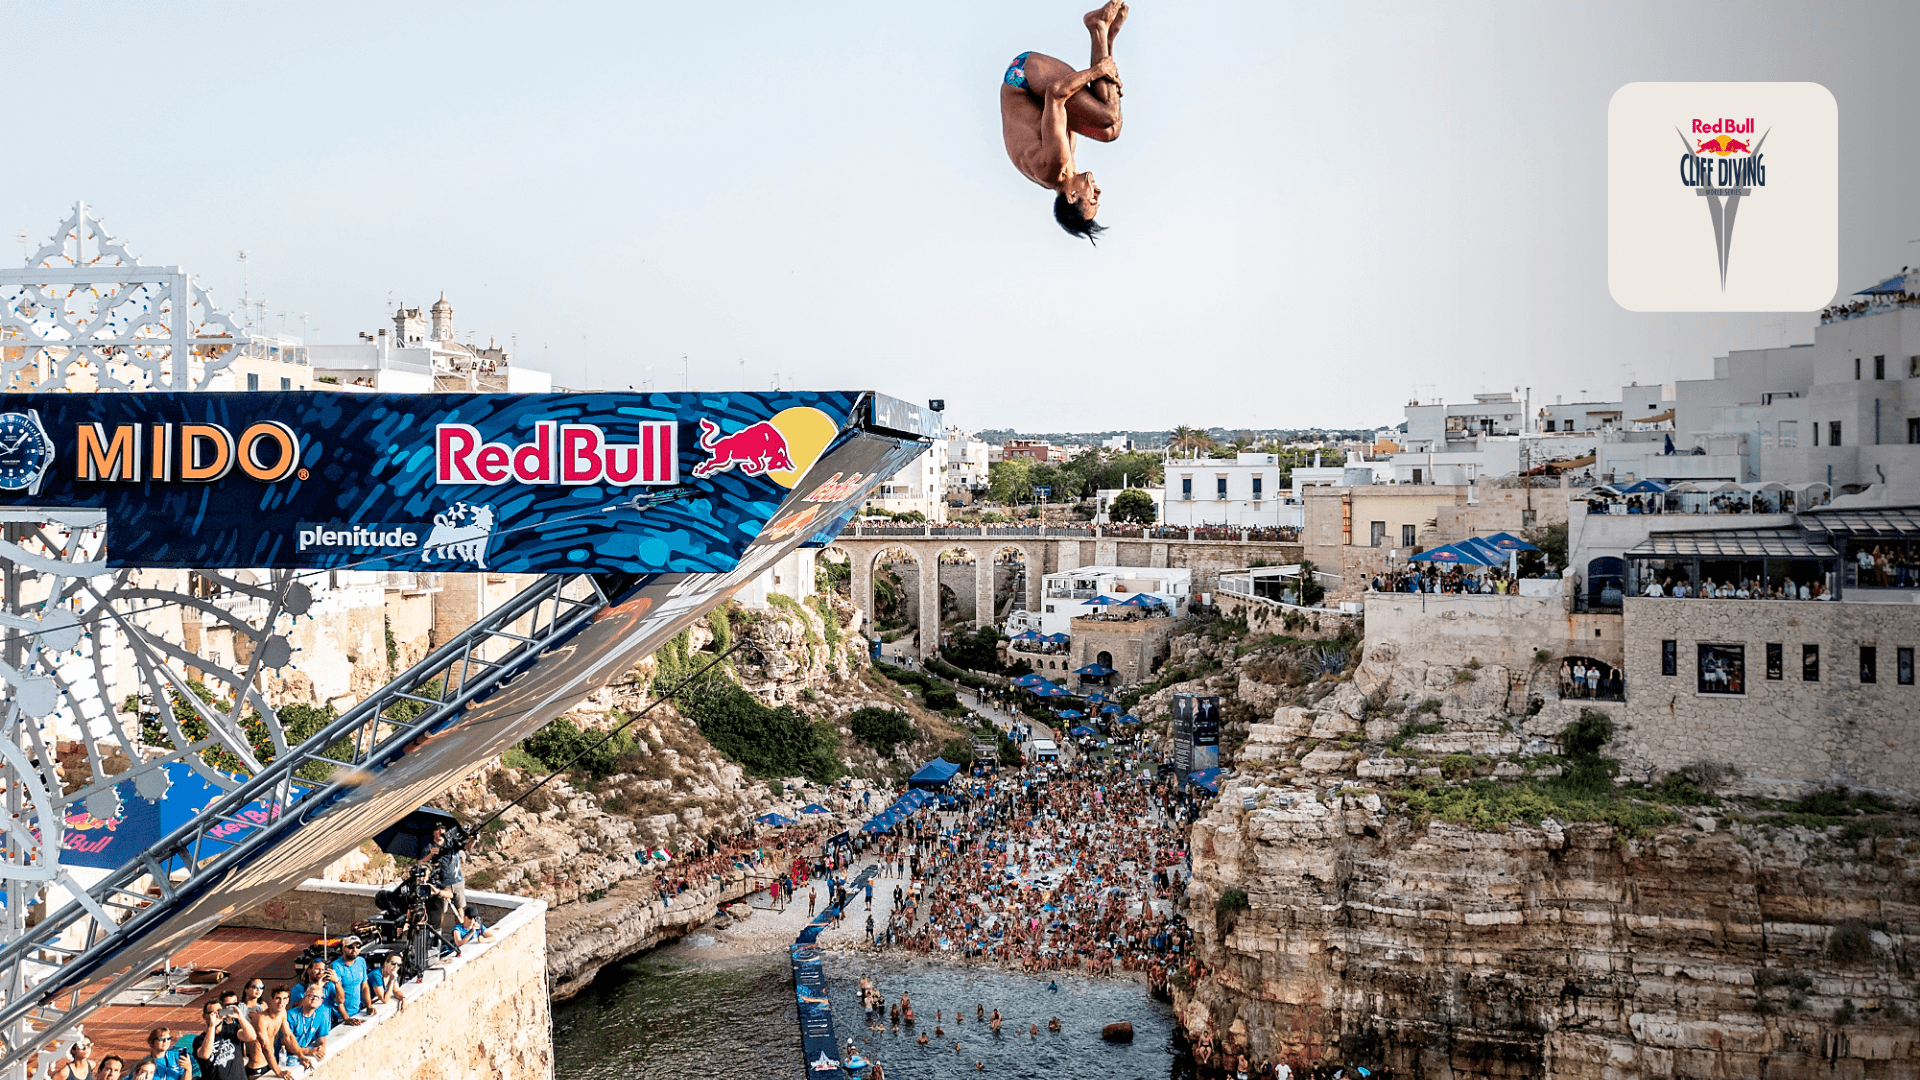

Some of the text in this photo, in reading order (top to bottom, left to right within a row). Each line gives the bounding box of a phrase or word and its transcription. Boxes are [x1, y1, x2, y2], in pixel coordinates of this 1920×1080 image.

[438, 423, 674, 484] Red Bull
[299, 525, 418, 551] plenitude
[66, 833, 115, 853] Bull
